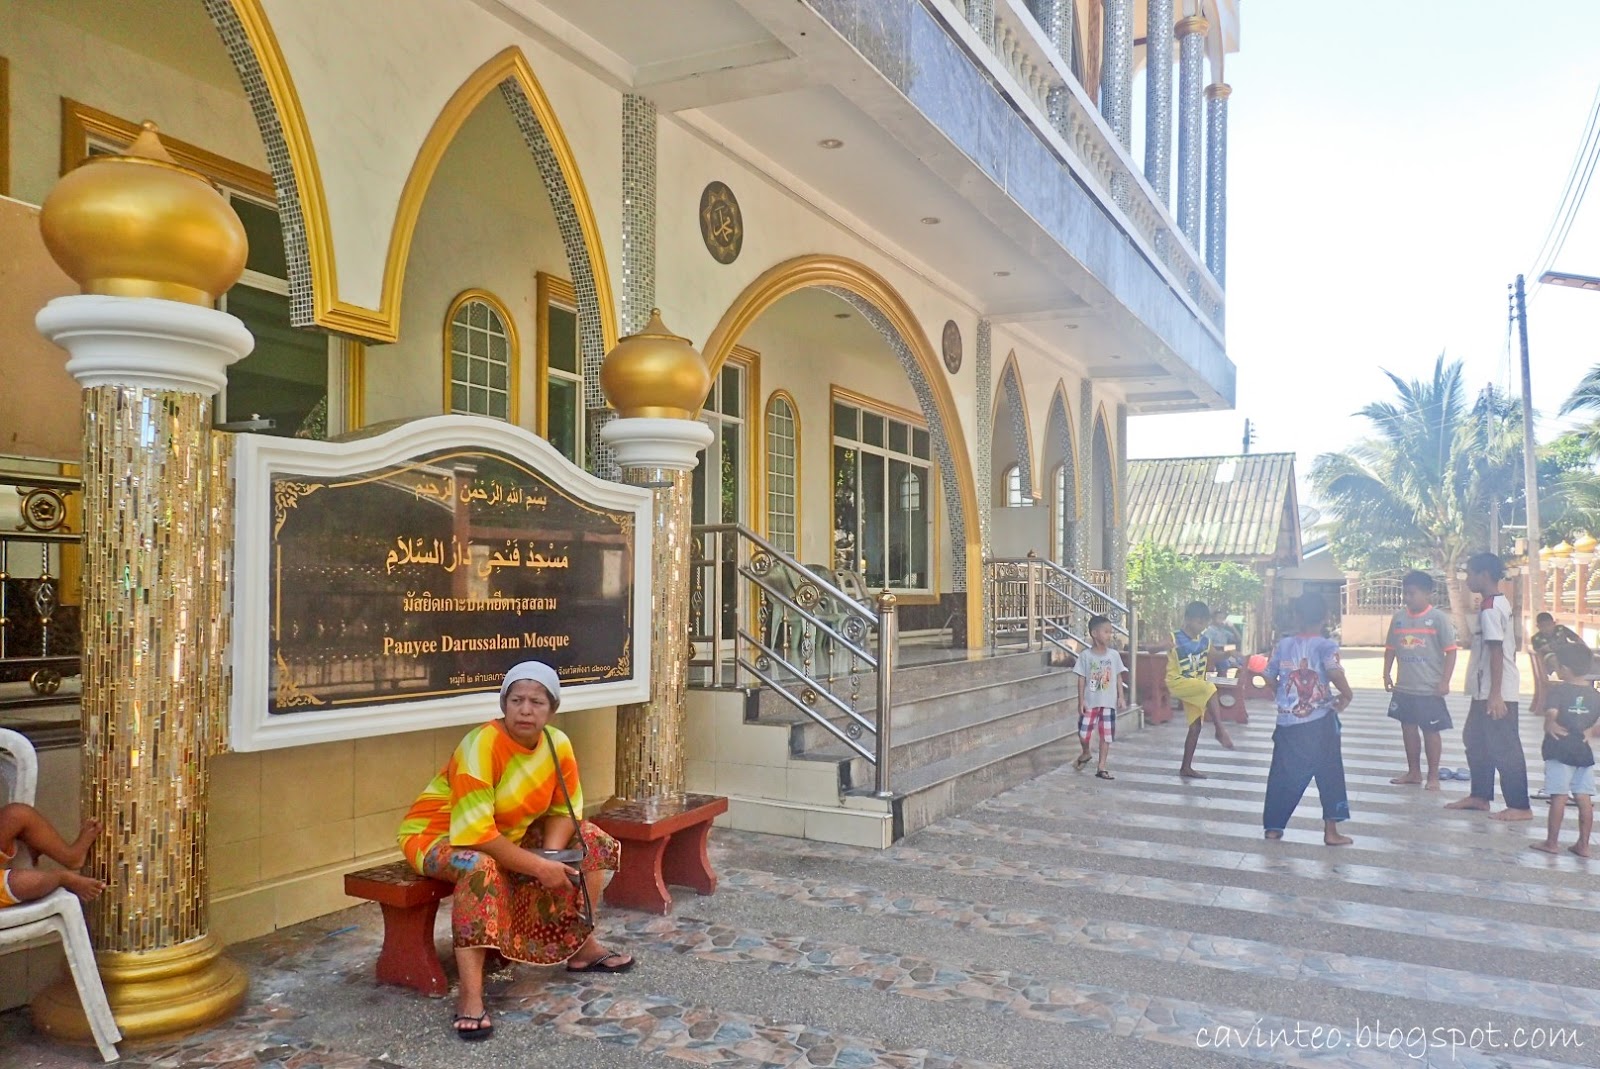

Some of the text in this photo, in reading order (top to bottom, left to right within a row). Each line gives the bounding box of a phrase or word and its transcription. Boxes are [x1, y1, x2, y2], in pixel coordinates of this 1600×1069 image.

[382, 631, 570, 658] Panyee Darussalam Mosque
